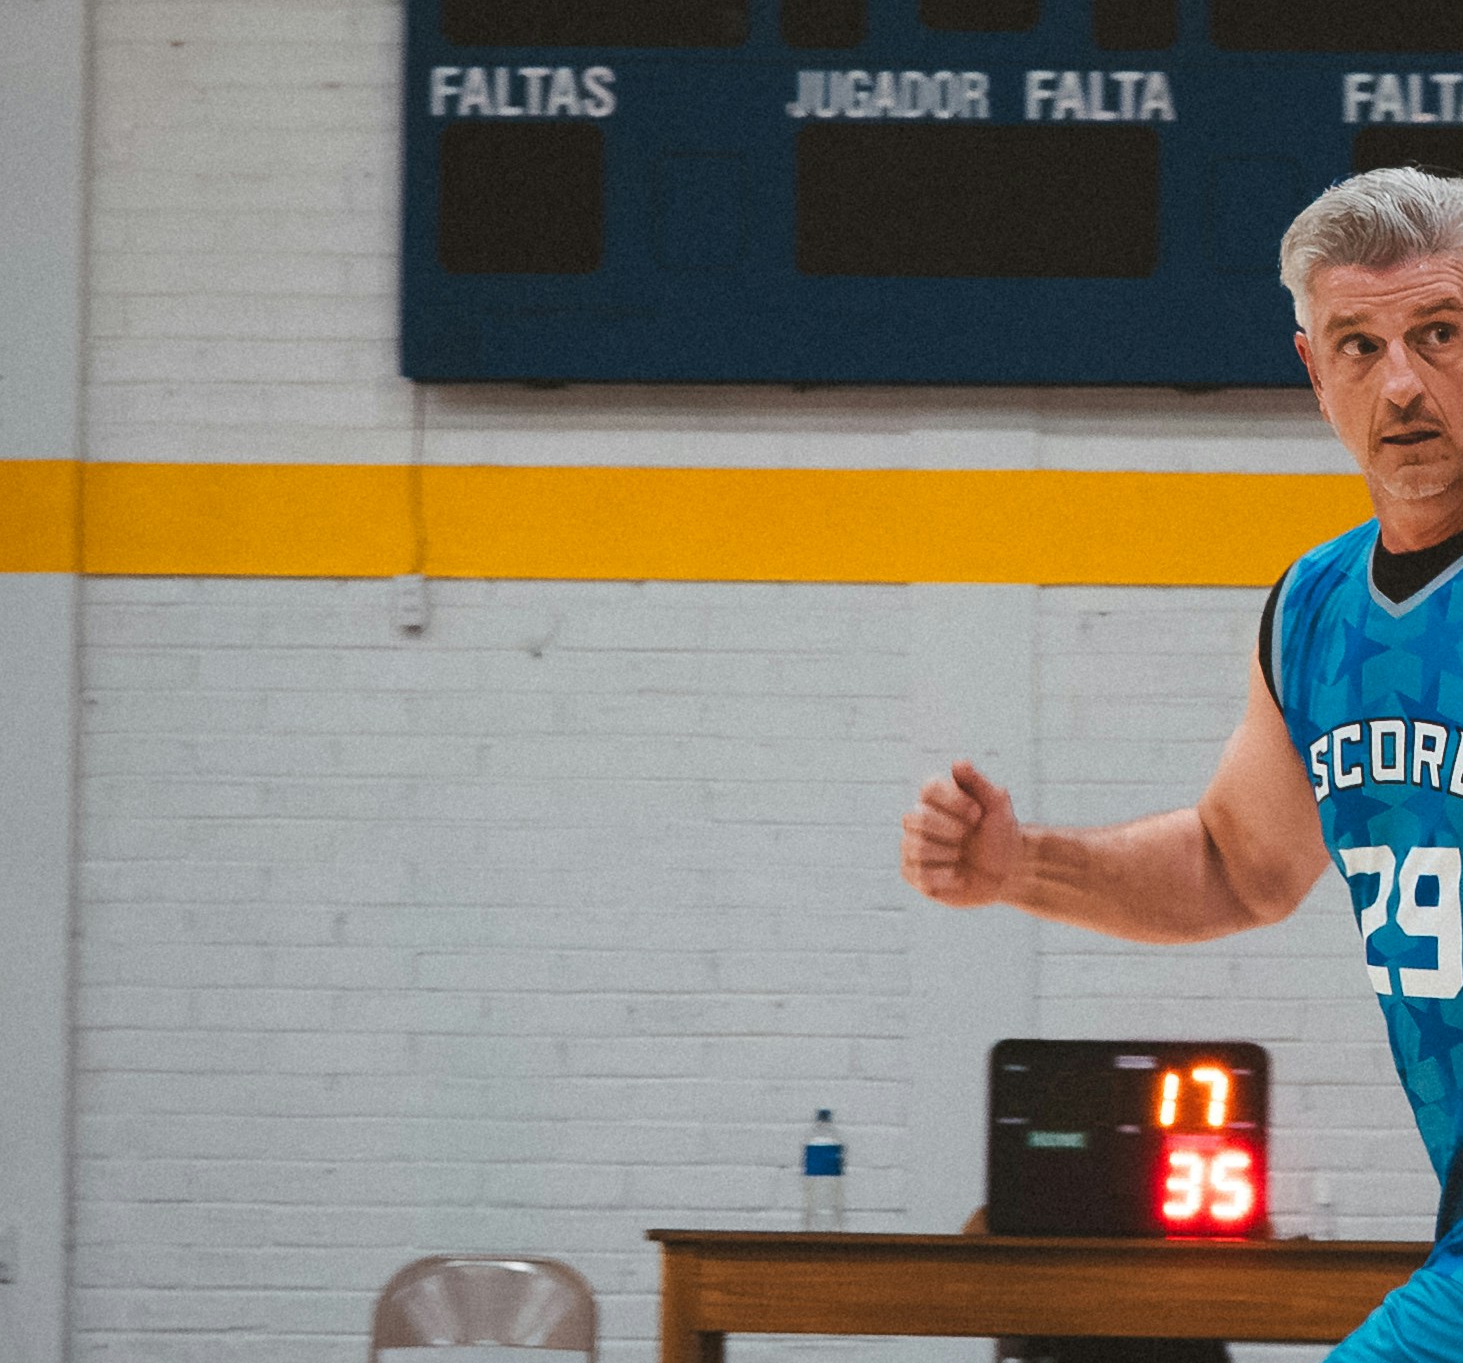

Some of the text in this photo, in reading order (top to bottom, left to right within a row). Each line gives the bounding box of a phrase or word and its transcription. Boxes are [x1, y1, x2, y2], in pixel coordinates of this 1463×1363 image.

[428, 65, 618, 118] FALTAS
[785, 69, 1178, 121] JUGADOR FALTA
[1157, 1065, 1232, 1128] 17
[1160, 1149, 1256, 1221] 35
